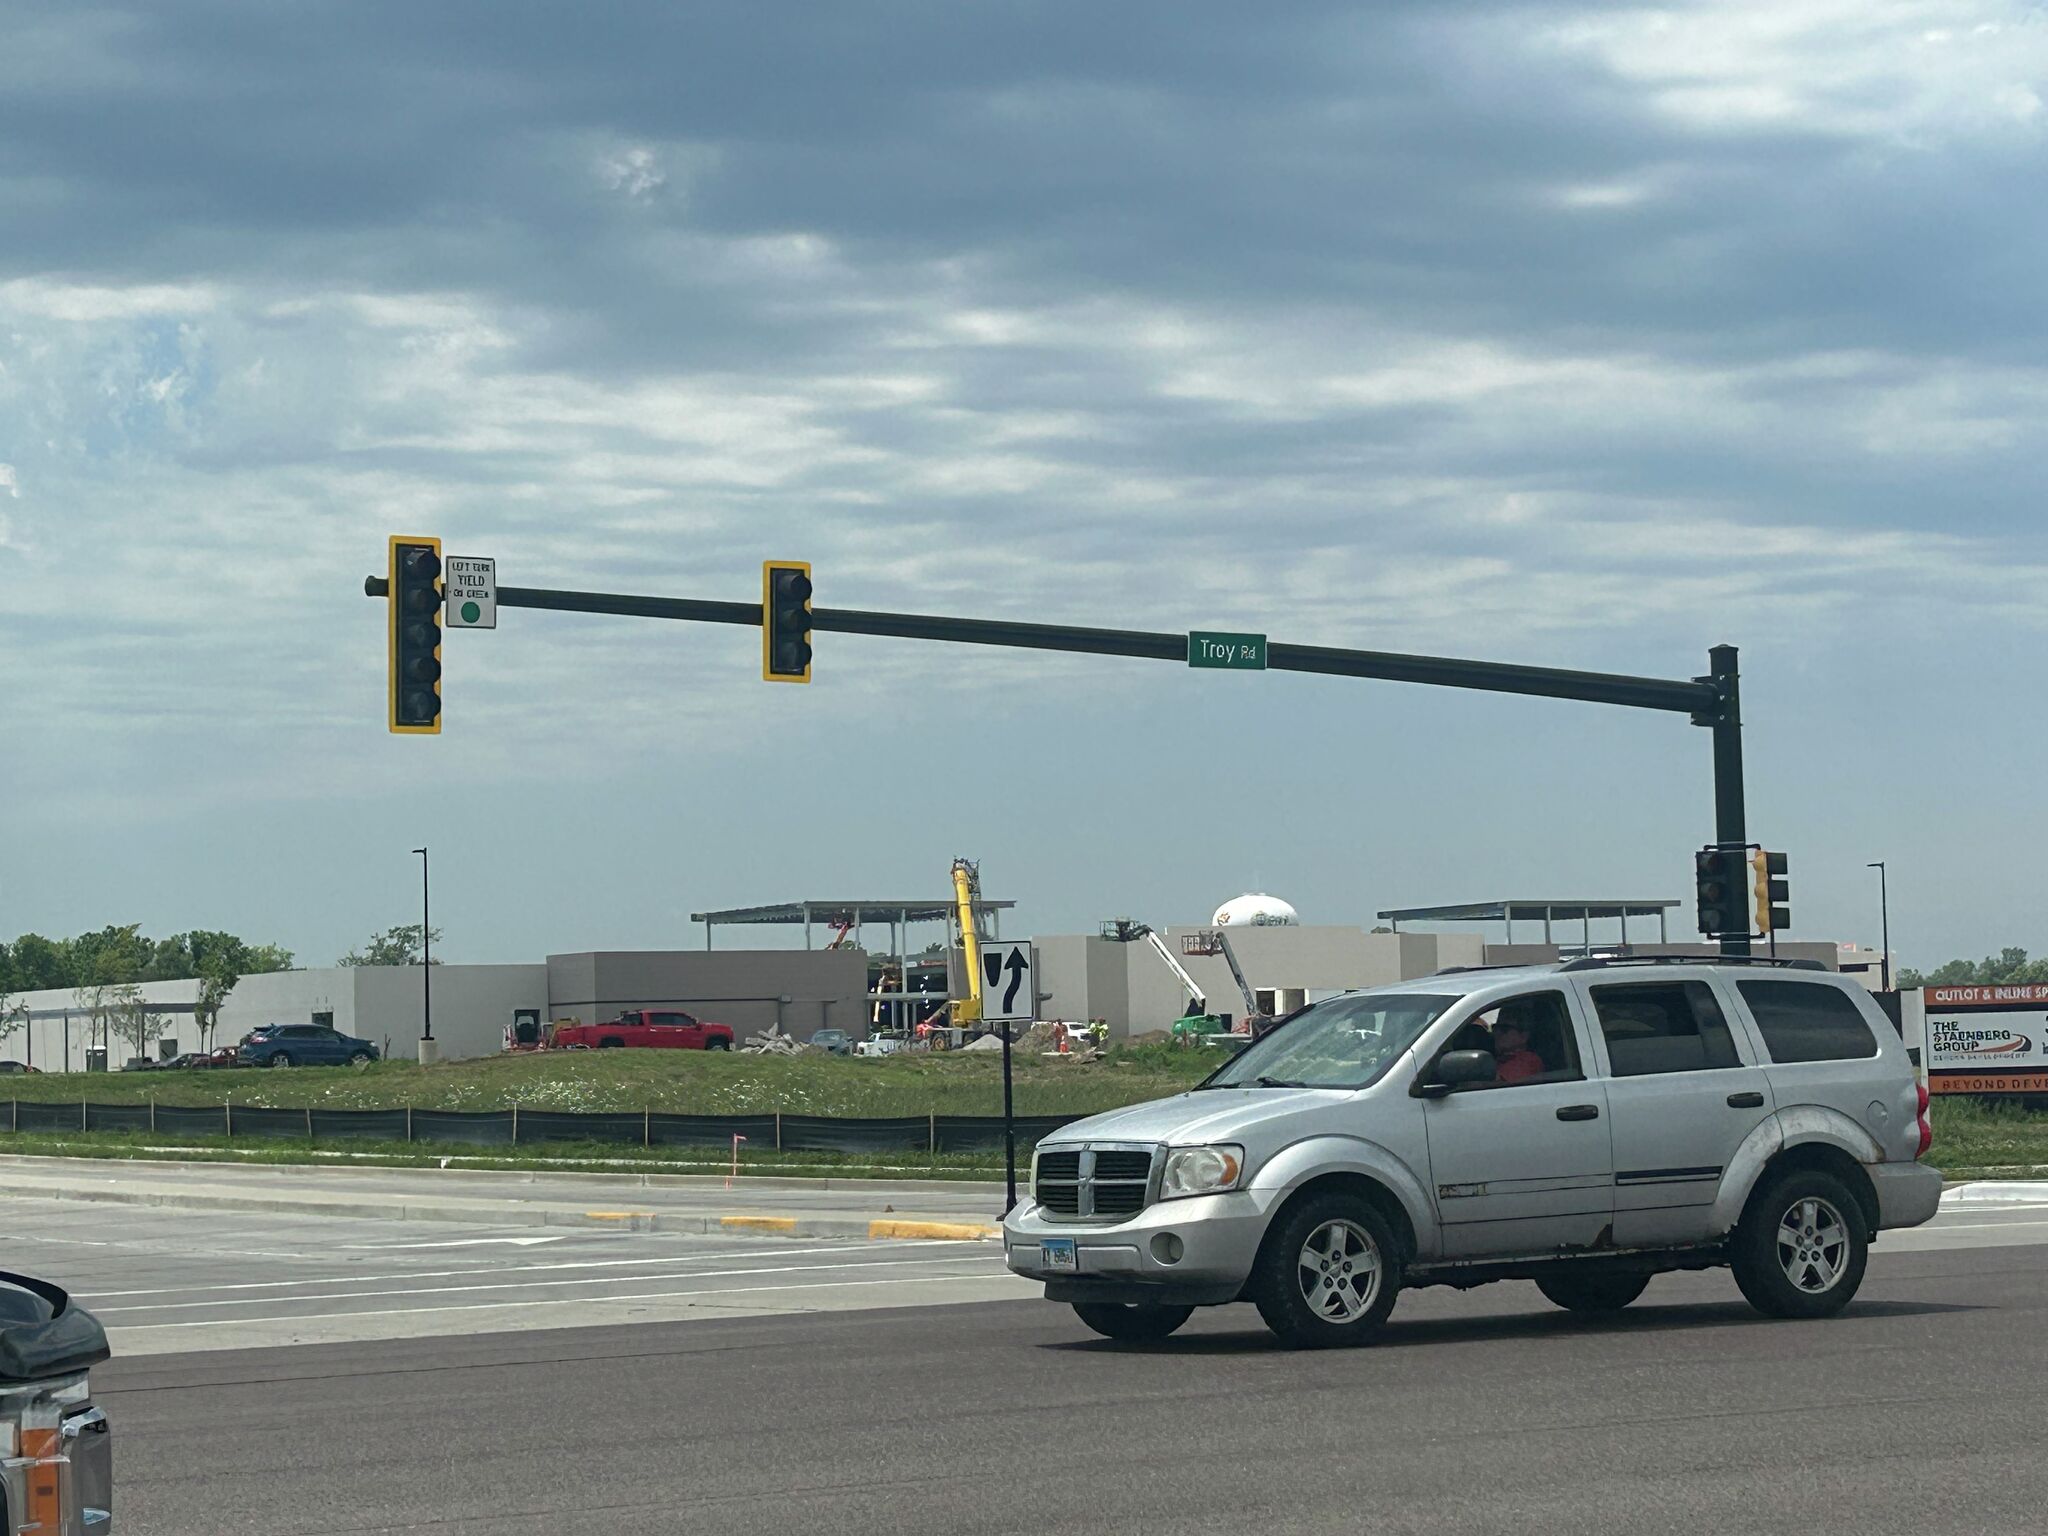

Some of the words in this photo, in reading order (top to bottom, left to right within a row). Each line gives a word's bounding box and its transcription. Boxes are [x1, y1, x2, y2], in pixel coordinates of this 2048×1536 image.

[457, 574, 485, 586] YIELD
[1200, 639, 1235, 663] Troy
[1240, 645, 1256, 659] Rd
[1935, 988, 1979, 1001] OUTLOT
[1932, 1021, 1960, 1032] THE
[1933, 1041, 1980, 1052] GROUP
[1942, 1079, 2006, 1091] BEYOND
